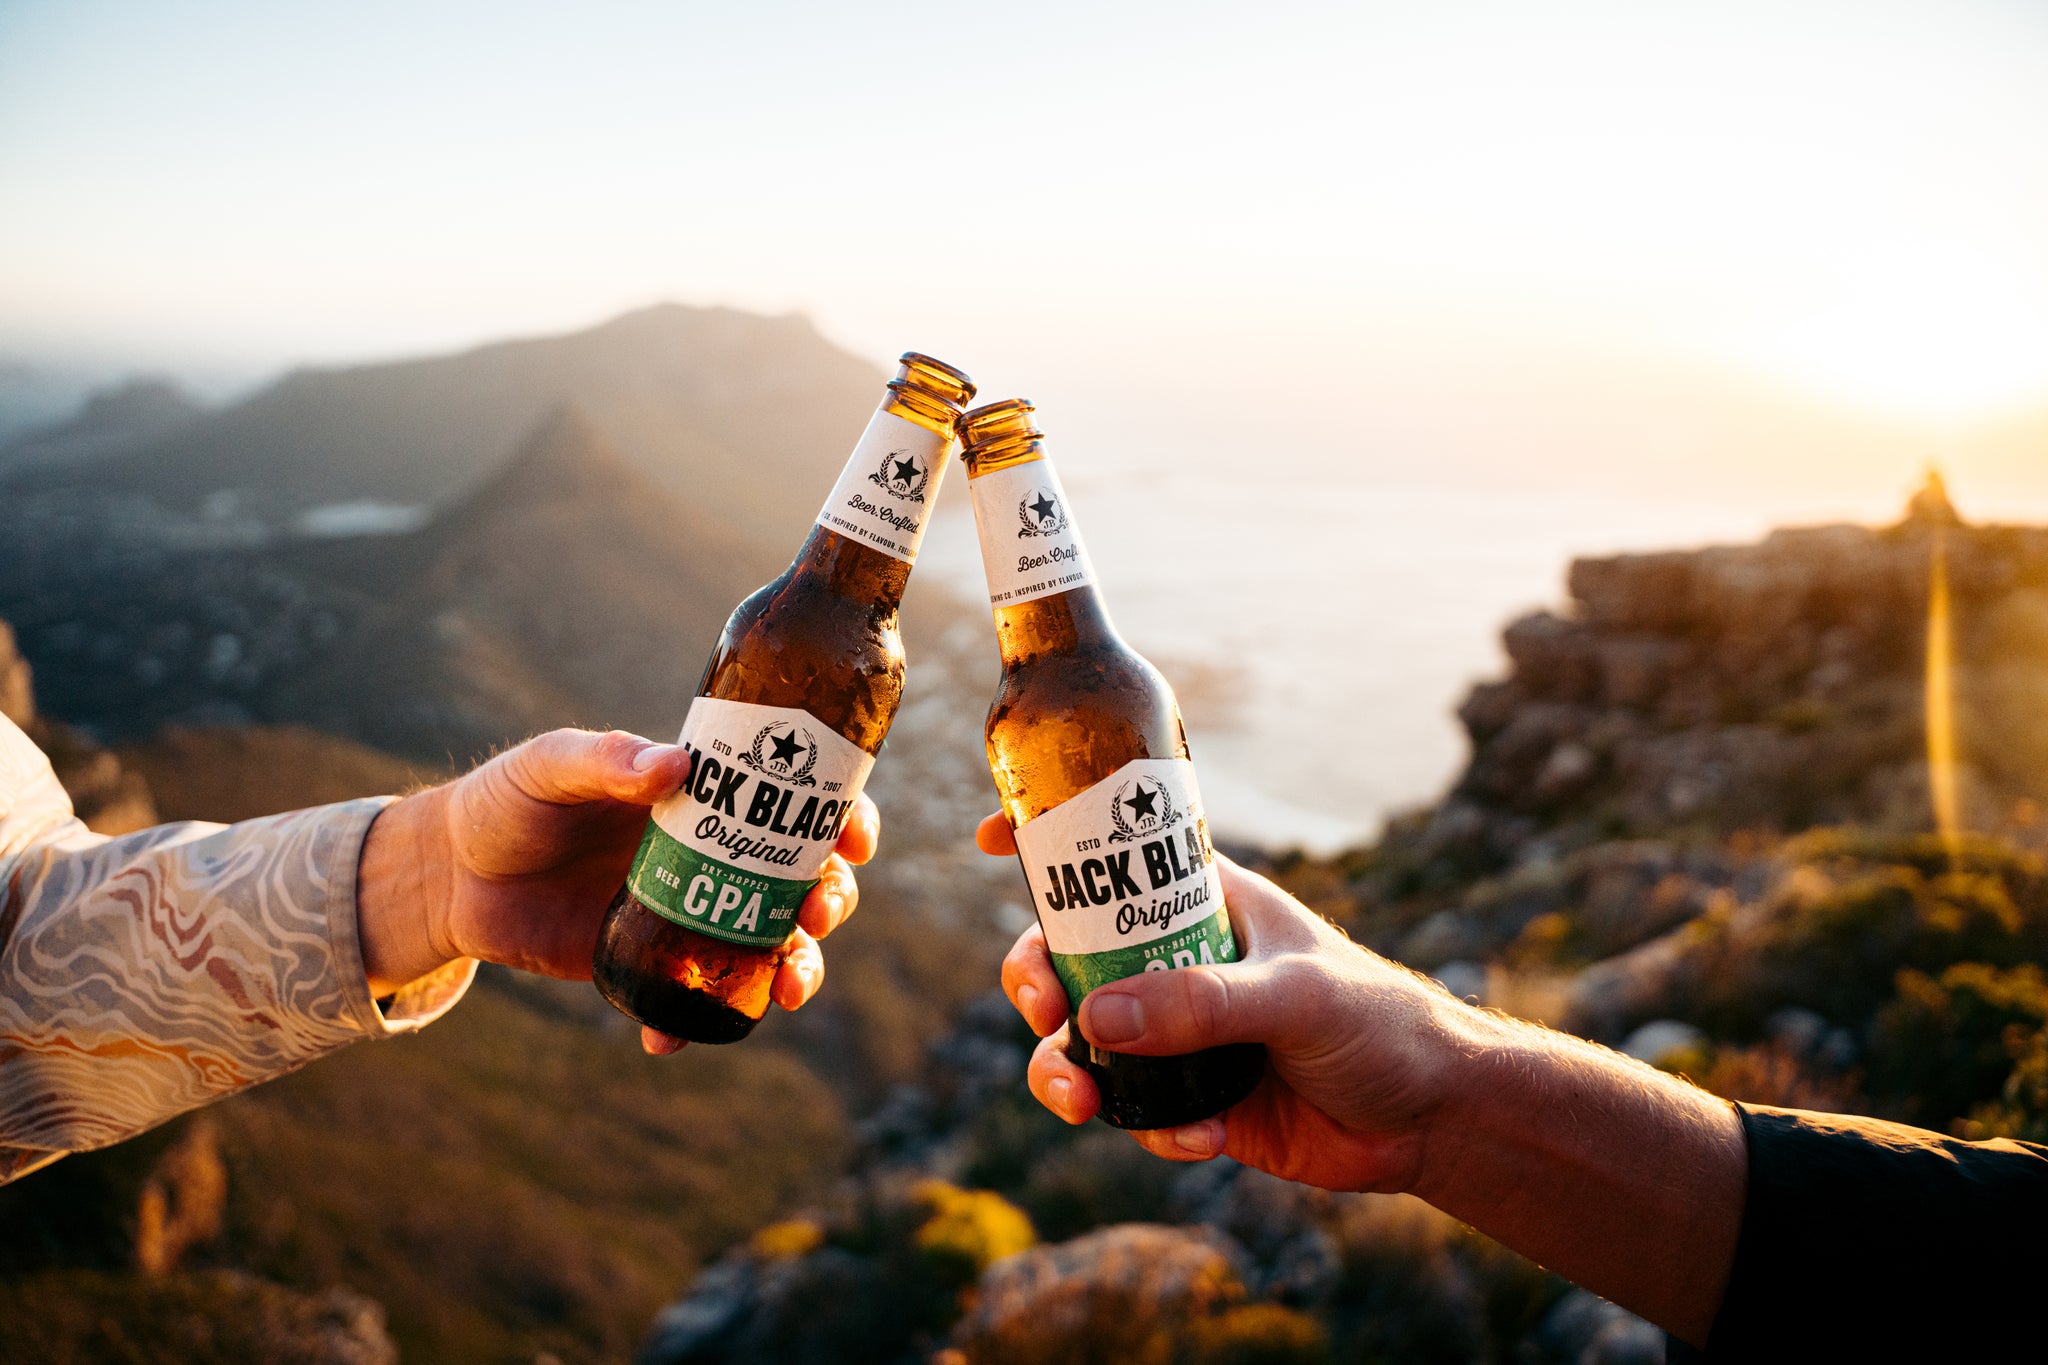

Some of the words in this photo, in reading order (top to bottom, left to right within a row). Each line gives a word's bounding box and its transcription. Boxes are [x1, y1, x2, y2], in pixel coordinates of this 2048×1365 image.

[893, 480, 907, 492] JB
[831, 516, 858, 533] INSPIRED
[859, 528, 869, 537] BY
[1043, 518, 1056, 529] JB
[1014, 582, 1046, 598] INSPIRED
[1047, 579, 1057, 588] BY
[711, 738, 732, 756] ESTD
[769, 760, 788, 774] JB
[679, 741, 749, 818] ACK
[745, 780, 854, 842] BLACK
[822, 780, 842, 793] 2007
[1140, 816, 1157, 830] JB
[694, 814, 804, 867] Original
[1076, 837, 1101, 852] ESTD
[1045, 849, 1143, 912] JACK
[1141, 818, 1213, 891] BLAC
[655, 866, 681, 890] BEER
[701, 862, 770, 892] DRY-HOPPED
[683, 873, 764, 932] CPA
[768, 904, 793, 920] BIÈRE
[1115, 876, 1211, 936] Original
[1143, 927, 1208, 959] DRY-HOPPED
